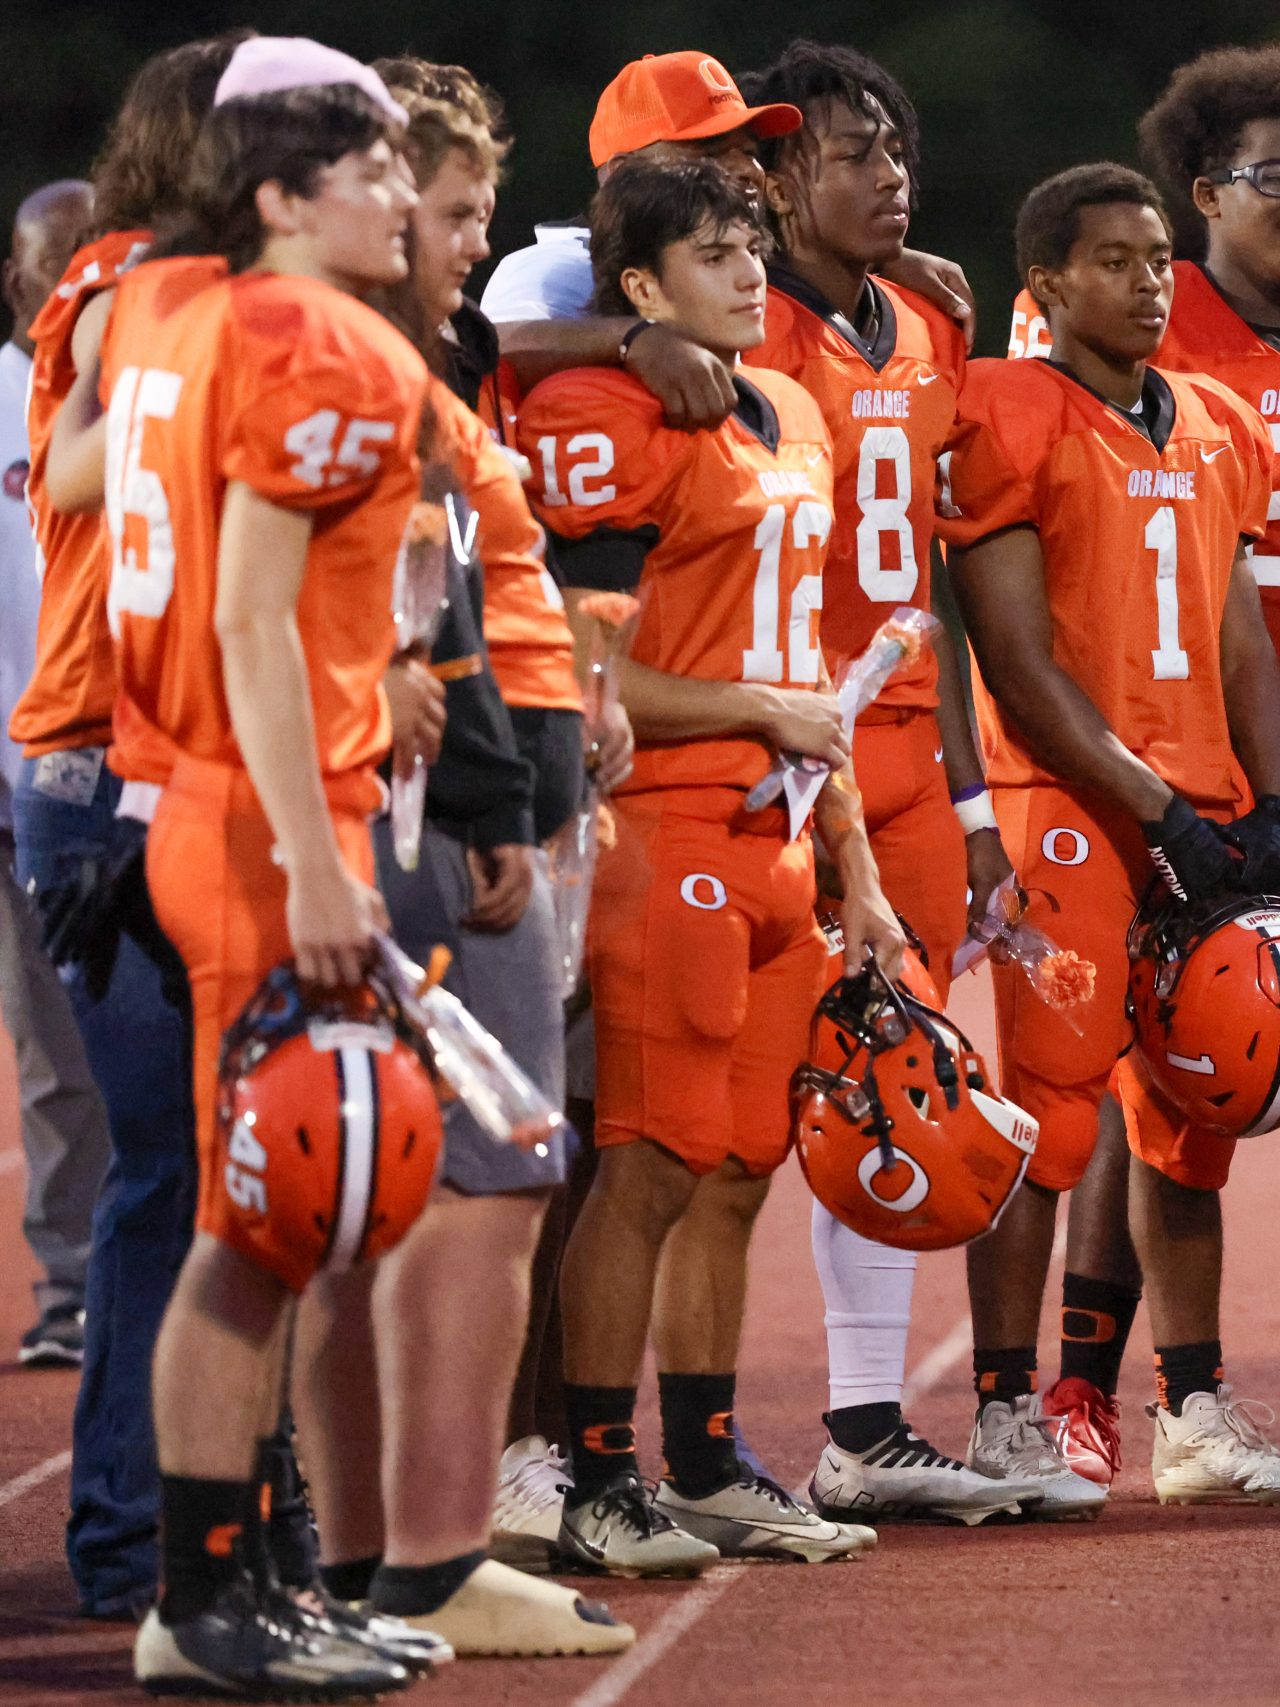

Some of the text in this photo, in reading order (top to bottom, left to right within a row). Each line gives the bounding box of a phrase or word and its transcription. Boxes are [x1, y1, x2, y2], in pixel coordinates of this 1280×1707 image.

[851, 389, 911, 419] ORANGE
[284, 409, 394, 488] 45
[535, 433, 617, 507] 12
[1127, 469, 1196, 499] ORANGE
[856, 426, 919, 602] 8
[740, 502, 832, 683] 12
[1144, 506, 1190, 681] 1
